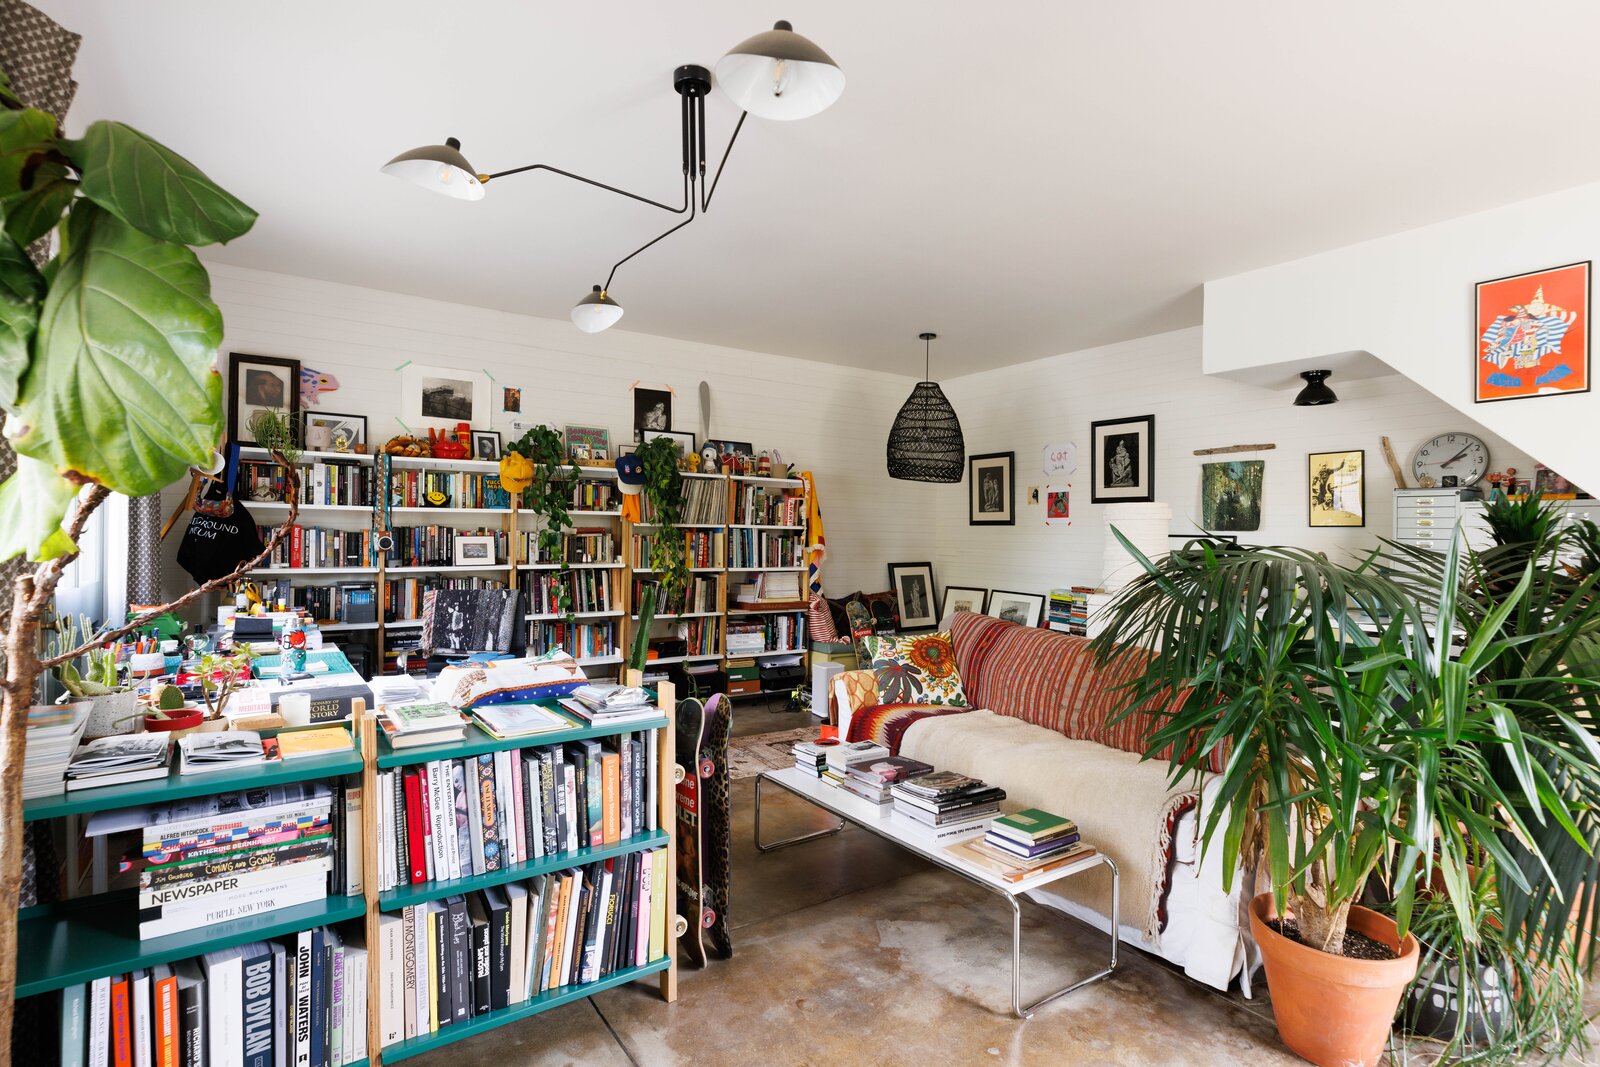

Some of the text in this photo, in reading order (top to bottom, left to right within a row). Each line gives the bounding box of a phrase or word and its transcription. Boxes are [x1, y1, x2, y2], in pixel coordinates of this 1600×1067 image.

[310, 710, 338, 718] ISTORY
[676, 791, 694, 808] reme
[180, 827, 209, 838] HITCHCOCK
[188, 845, 231, 858] KATHERINE
[151, 878, 238, 905] NEWSPAPER
[266, 884, 288, 893] OWENS
[206, 899, 276, 921] PURPLE NEW YORK
[606, 894, 616, 924] FIORUCCI
[404, 906, 416, 990] HILIP MONTGOMERY
[299, 946, 310, 978] JOHN
[334, 952, 342, 1004] AGNES VARDA
[246, 960, 271, 1057] BOB DYLAN
[298, 995, 309, 1042] WATERS
